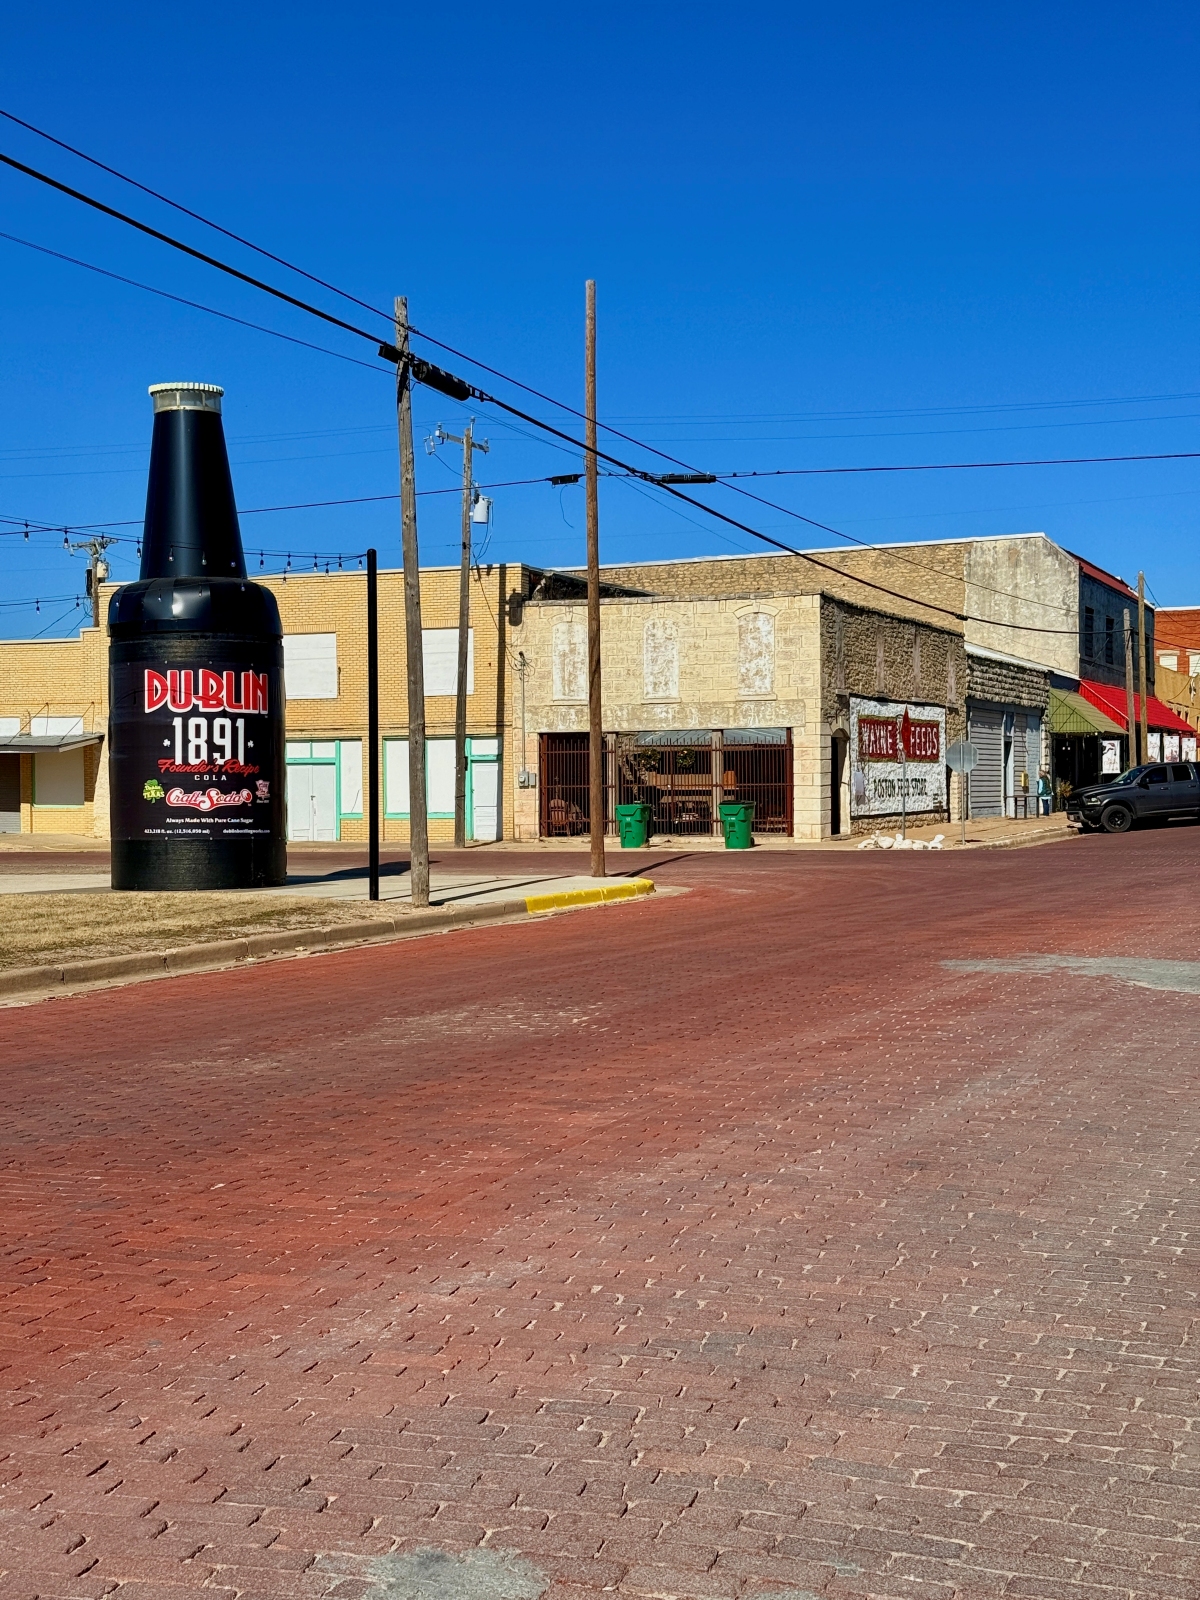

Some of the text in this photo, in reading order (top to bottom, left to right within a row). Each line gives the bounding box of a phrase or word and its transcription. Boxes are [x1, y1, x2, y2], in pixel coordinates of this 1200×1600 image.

[144, 669, 269, 714] DUBLIN
[172, 717, 244, 766] 1891
[861, 723, 938, 756] WAYNE FEEDS
[157, 758, 260, 777] Founder's Recipe
[143, 790, 165, 799] TEXAS
[166, 787, 202, 806] Craft
